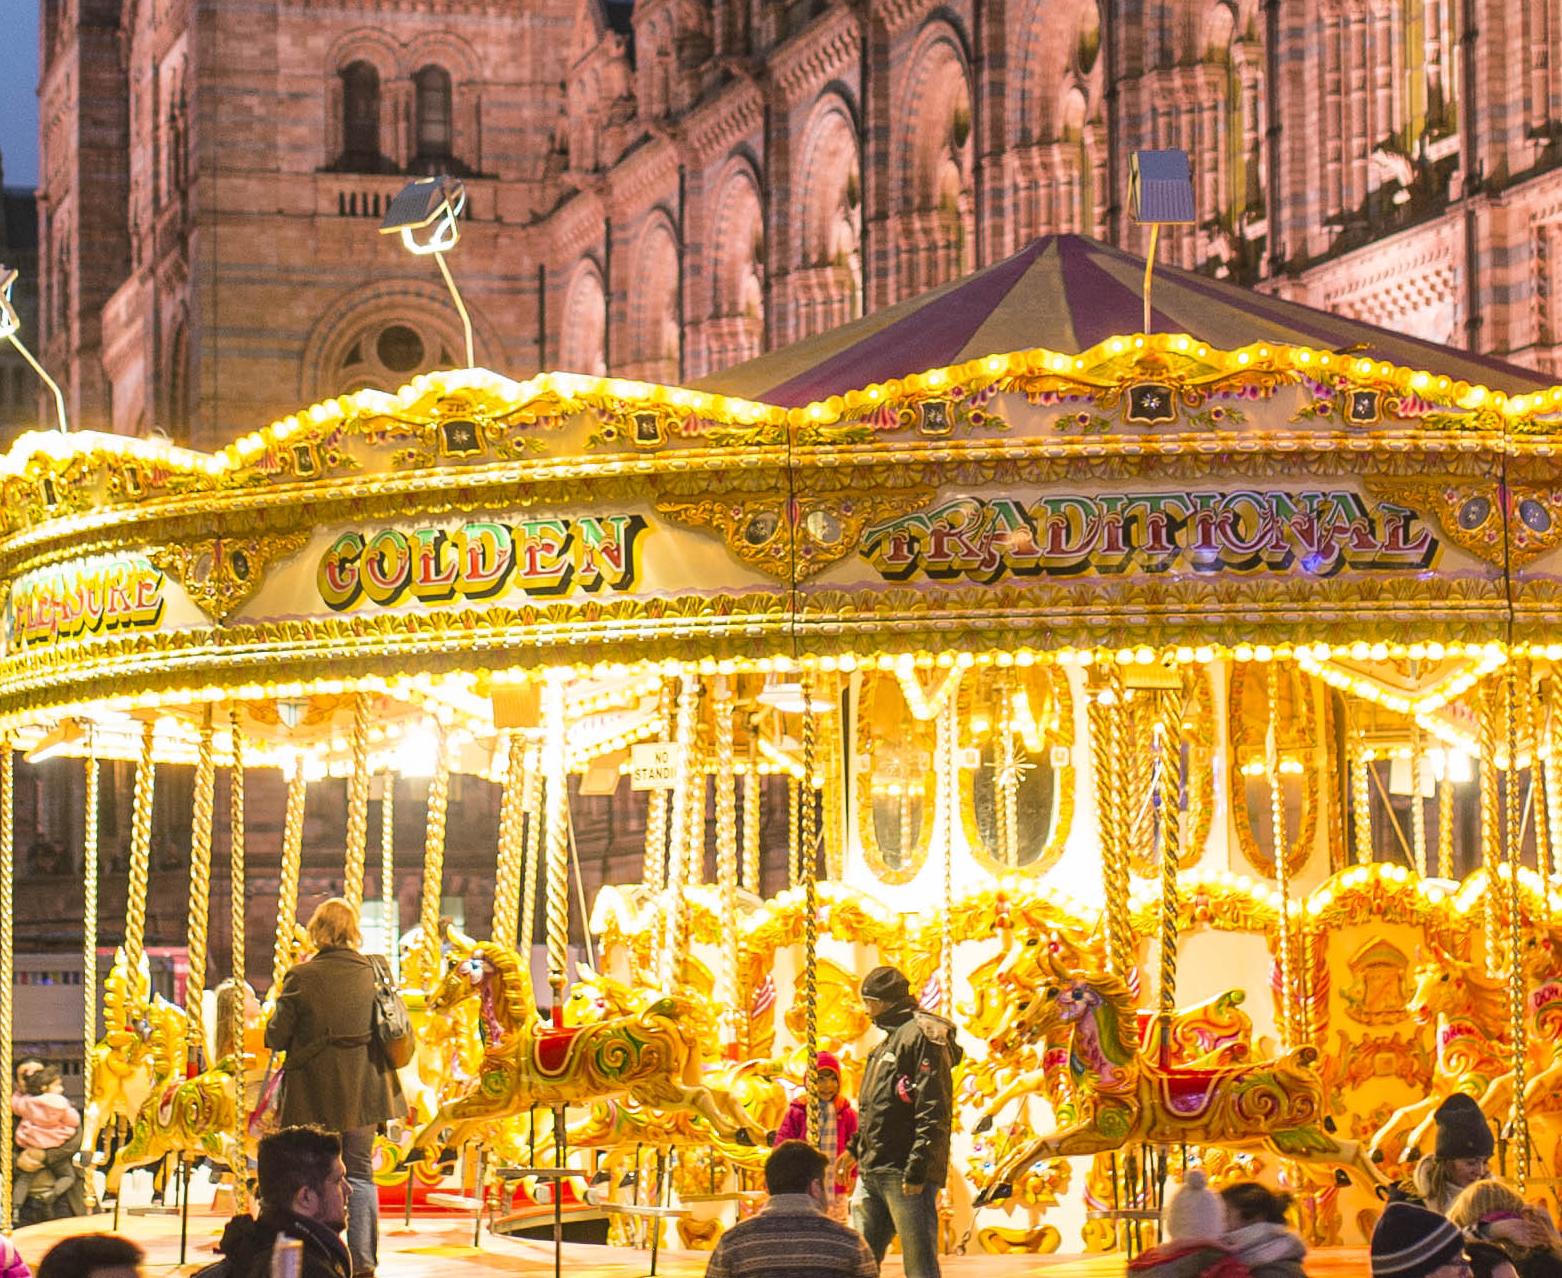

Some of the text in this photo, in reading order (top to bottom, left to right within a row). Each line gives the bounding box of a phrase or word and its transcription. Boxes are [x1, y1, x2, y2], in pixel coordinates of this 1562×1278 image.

[317, 514, 646, 612] GOLDEN
[861, 490, 1439, 580] TRADITIONAL
[10, 558, 166, 648] PLEASURE
[654, 751, 669, 764] NO
